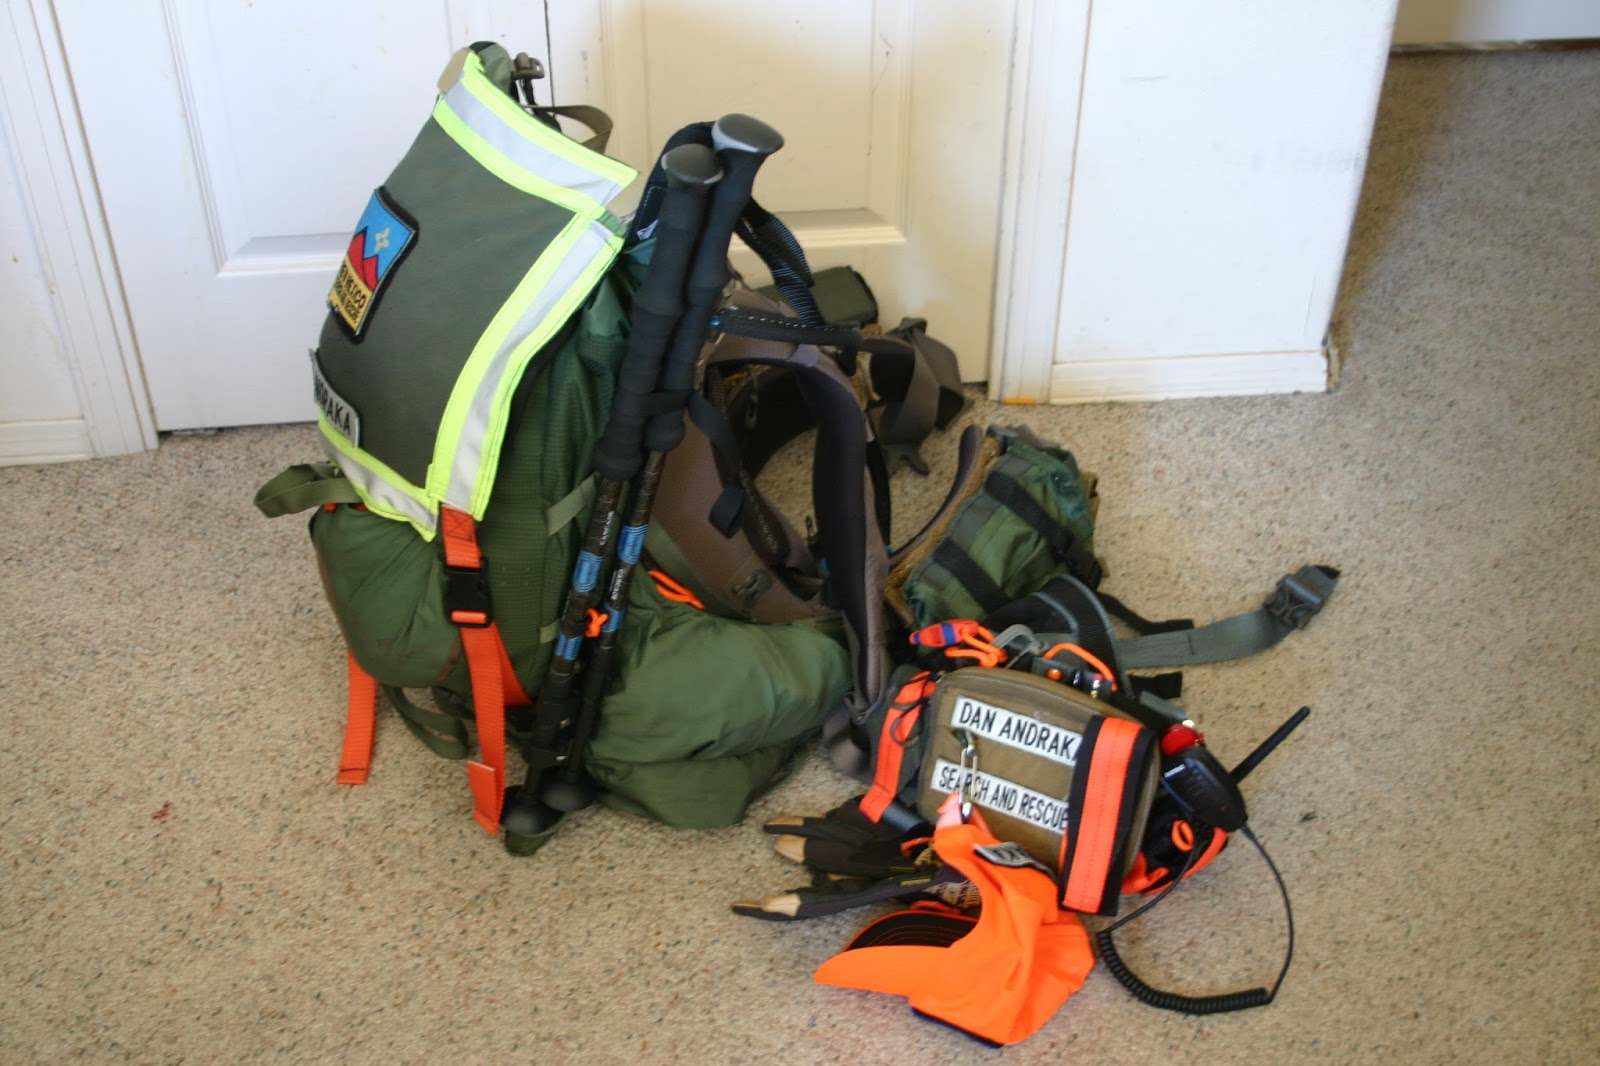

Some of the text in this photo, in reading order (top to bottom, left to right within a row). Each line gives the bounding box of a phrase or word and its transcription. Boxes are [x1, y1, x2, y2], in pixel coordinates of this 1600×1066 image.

[960, 701, 1077, 761] DAN ANDRAK
[991, 784, 1018, 812] AND
[1018, 794, 1069, 830] RESCUE
